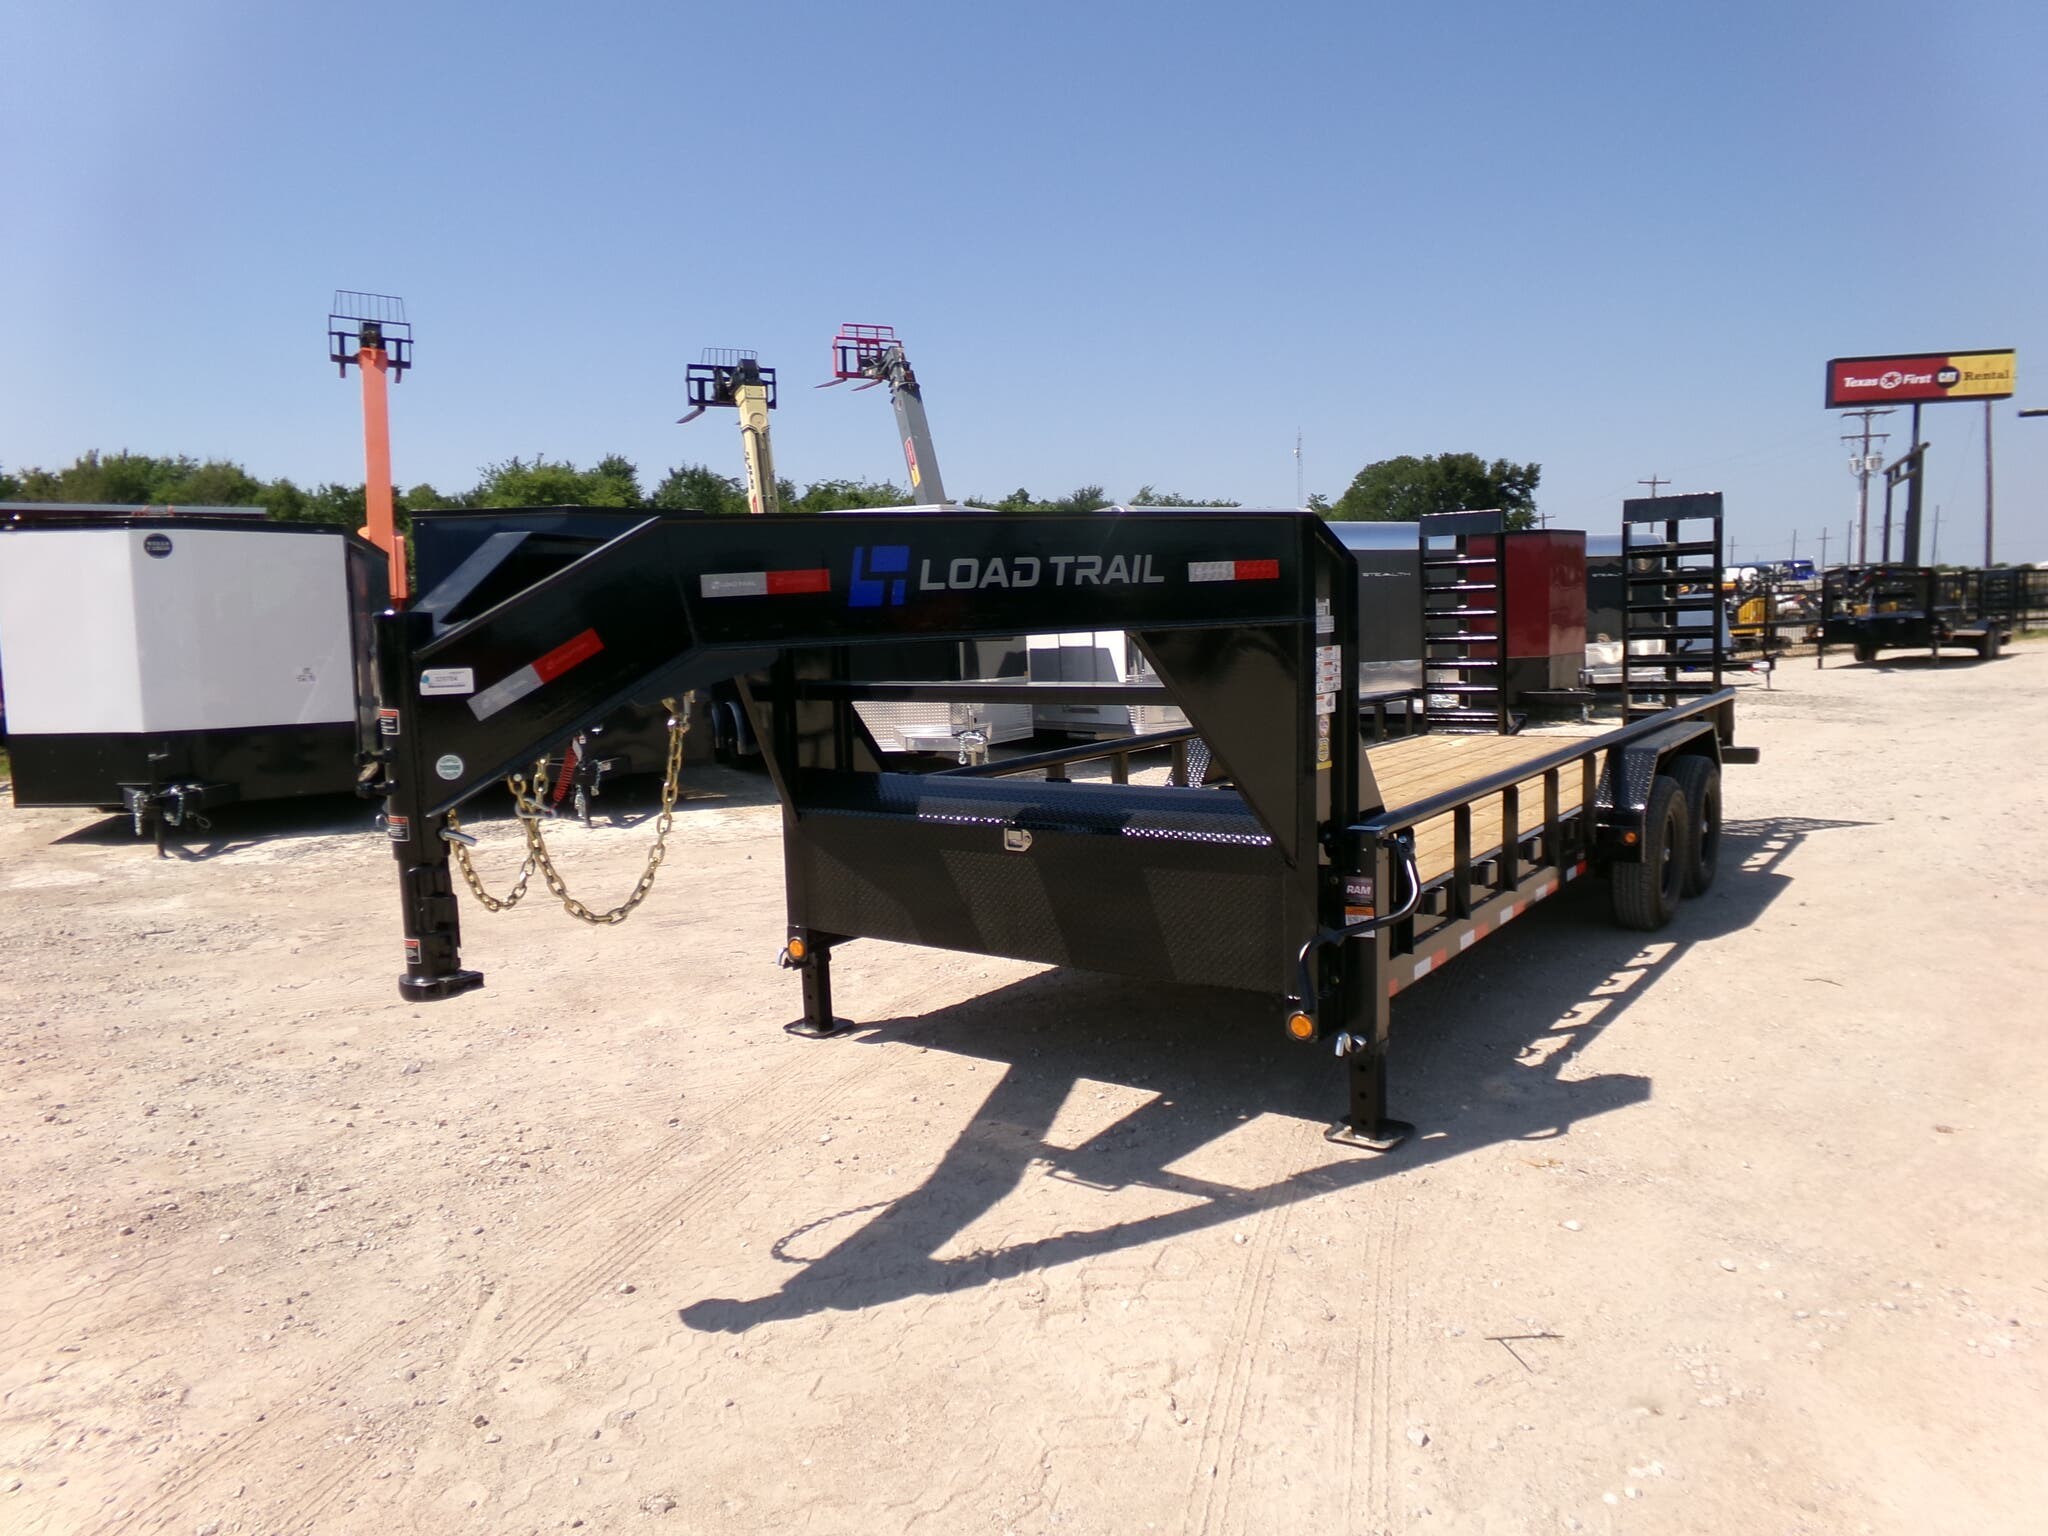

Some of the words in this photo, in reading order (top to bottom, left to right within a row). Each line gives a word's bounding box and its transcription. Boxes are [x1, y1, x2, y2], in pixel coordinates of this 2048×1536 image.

[1843, 377, 1878, 388] Texas
[1902, 374, 1932, 385] First
[1963, 370, 2009, 381] Rental
[919, 557, 1040, 591] LOAD
[1049, 554, 1165, 586] TRAIL
[1346, 885, 1372, 895] RAM
